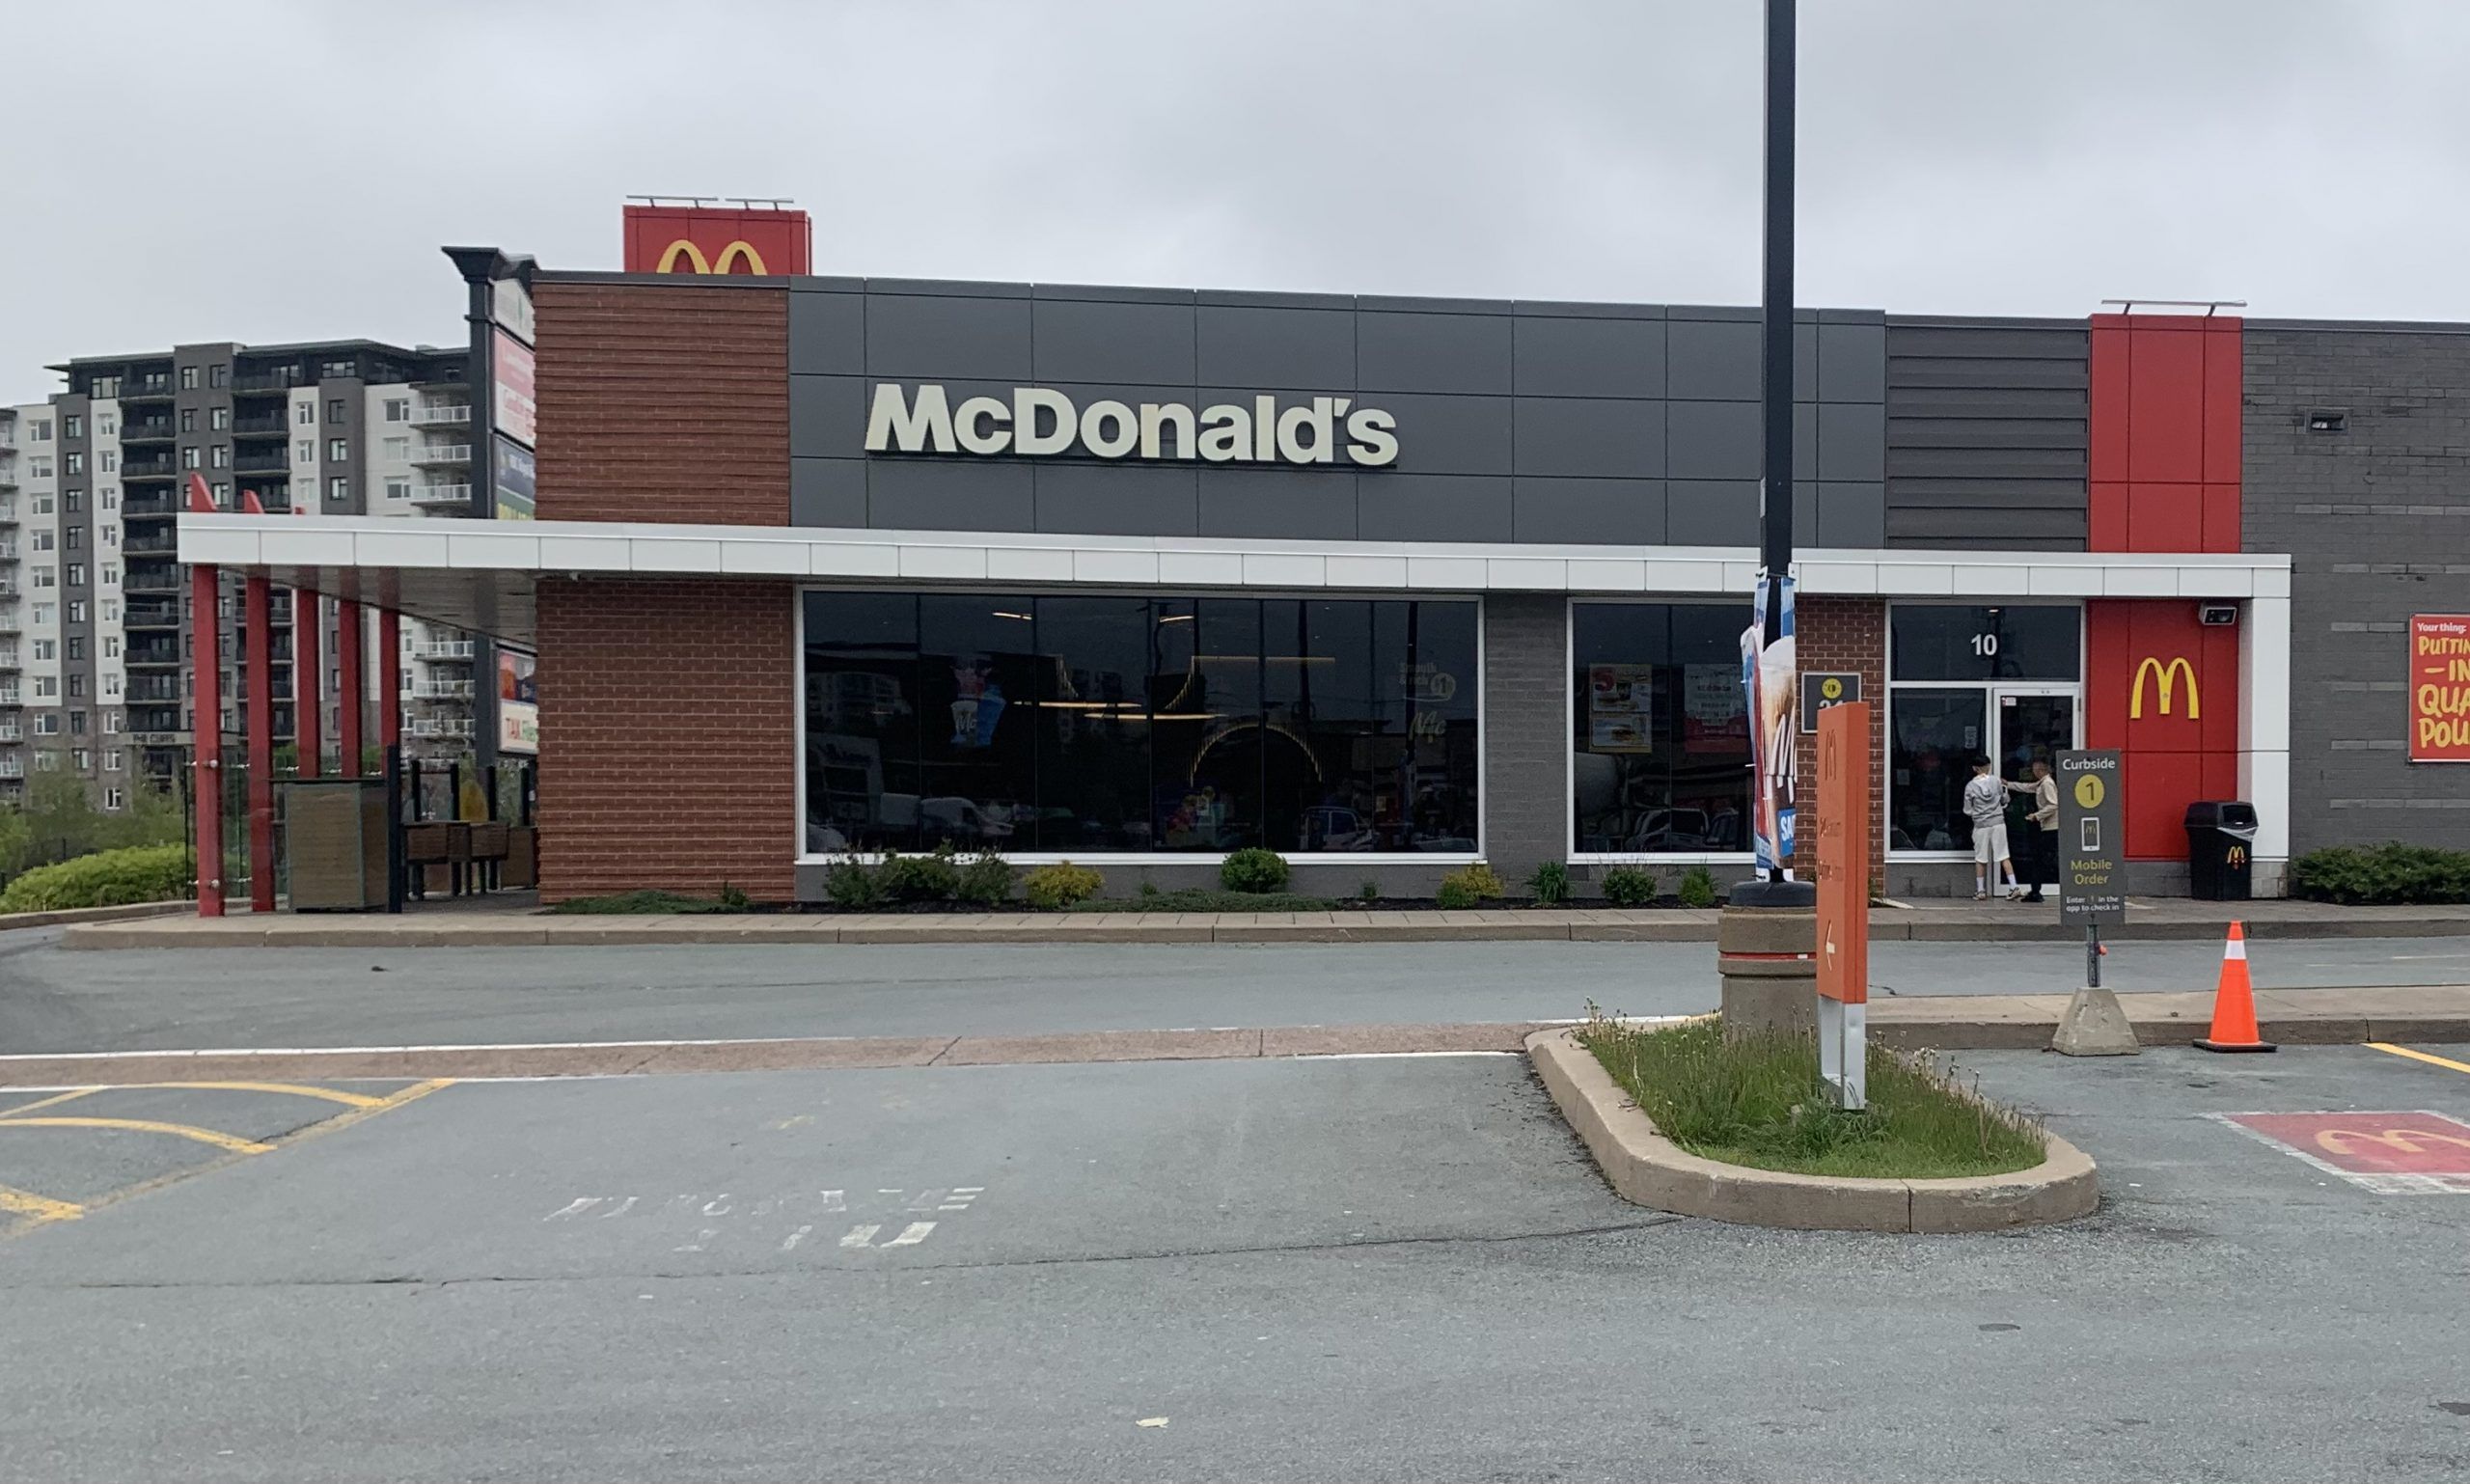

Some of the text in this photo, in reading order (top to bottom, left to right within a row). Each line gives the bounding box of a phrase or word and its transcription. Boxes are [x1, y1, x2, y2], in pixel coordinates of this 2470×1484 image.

[864, 383, 1399, 465] McDonald's
[2417, 622, 2438, 632] Your
[1971, 634, 1997, 655] 10
[2062, 757, 2116, 770] Curbside
[2085, 782, 2095, 801] 1
[2071, 859, 2112, 870] Mobile
[2074, 873, 2109, 885] Order
